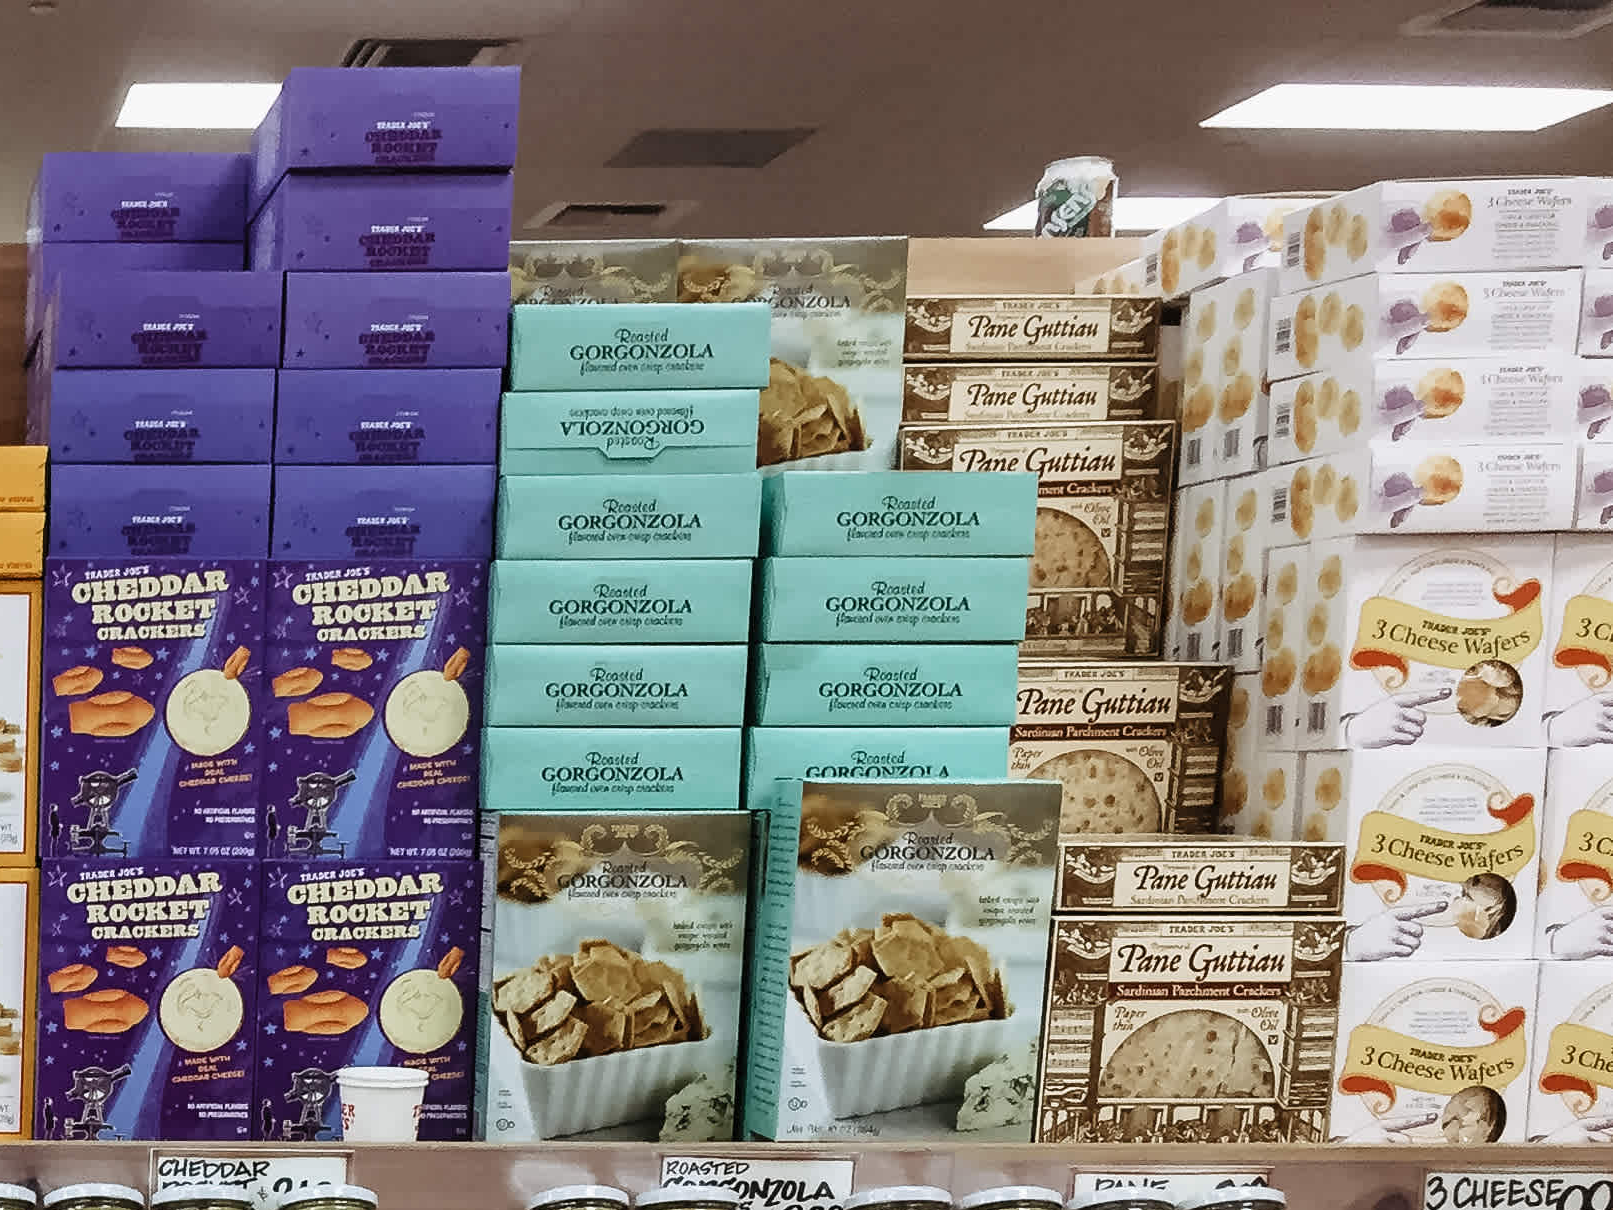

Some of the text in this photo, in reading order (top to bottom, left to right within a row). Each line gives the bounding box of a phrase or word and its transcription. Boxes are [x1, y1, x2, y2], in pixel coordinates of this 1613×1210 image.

[615, 328, 669, 344] Roasted
[569, 343, 715, 361] GORGONZOLA
[85, 568, 119, 579] TRADER
[71, 569, 229, 603] CHEDDAR
[91, 599, 215, 624] ROCKET
[97, 622, 206, 640] CRACKERS
[1372, 619, 1531, 657] 3 Cheese Wafers
[1118, 944, 1285, 981] Pane Guttiau
[1116, 984, 1281, 997] Sardinian Parchment Crackers
[158, 1159, 271, 1178] CHEDDAR
[666, 1161, 750, 1175] ROASTED
[1454, 1178, 1564, 1209] CHEESE
